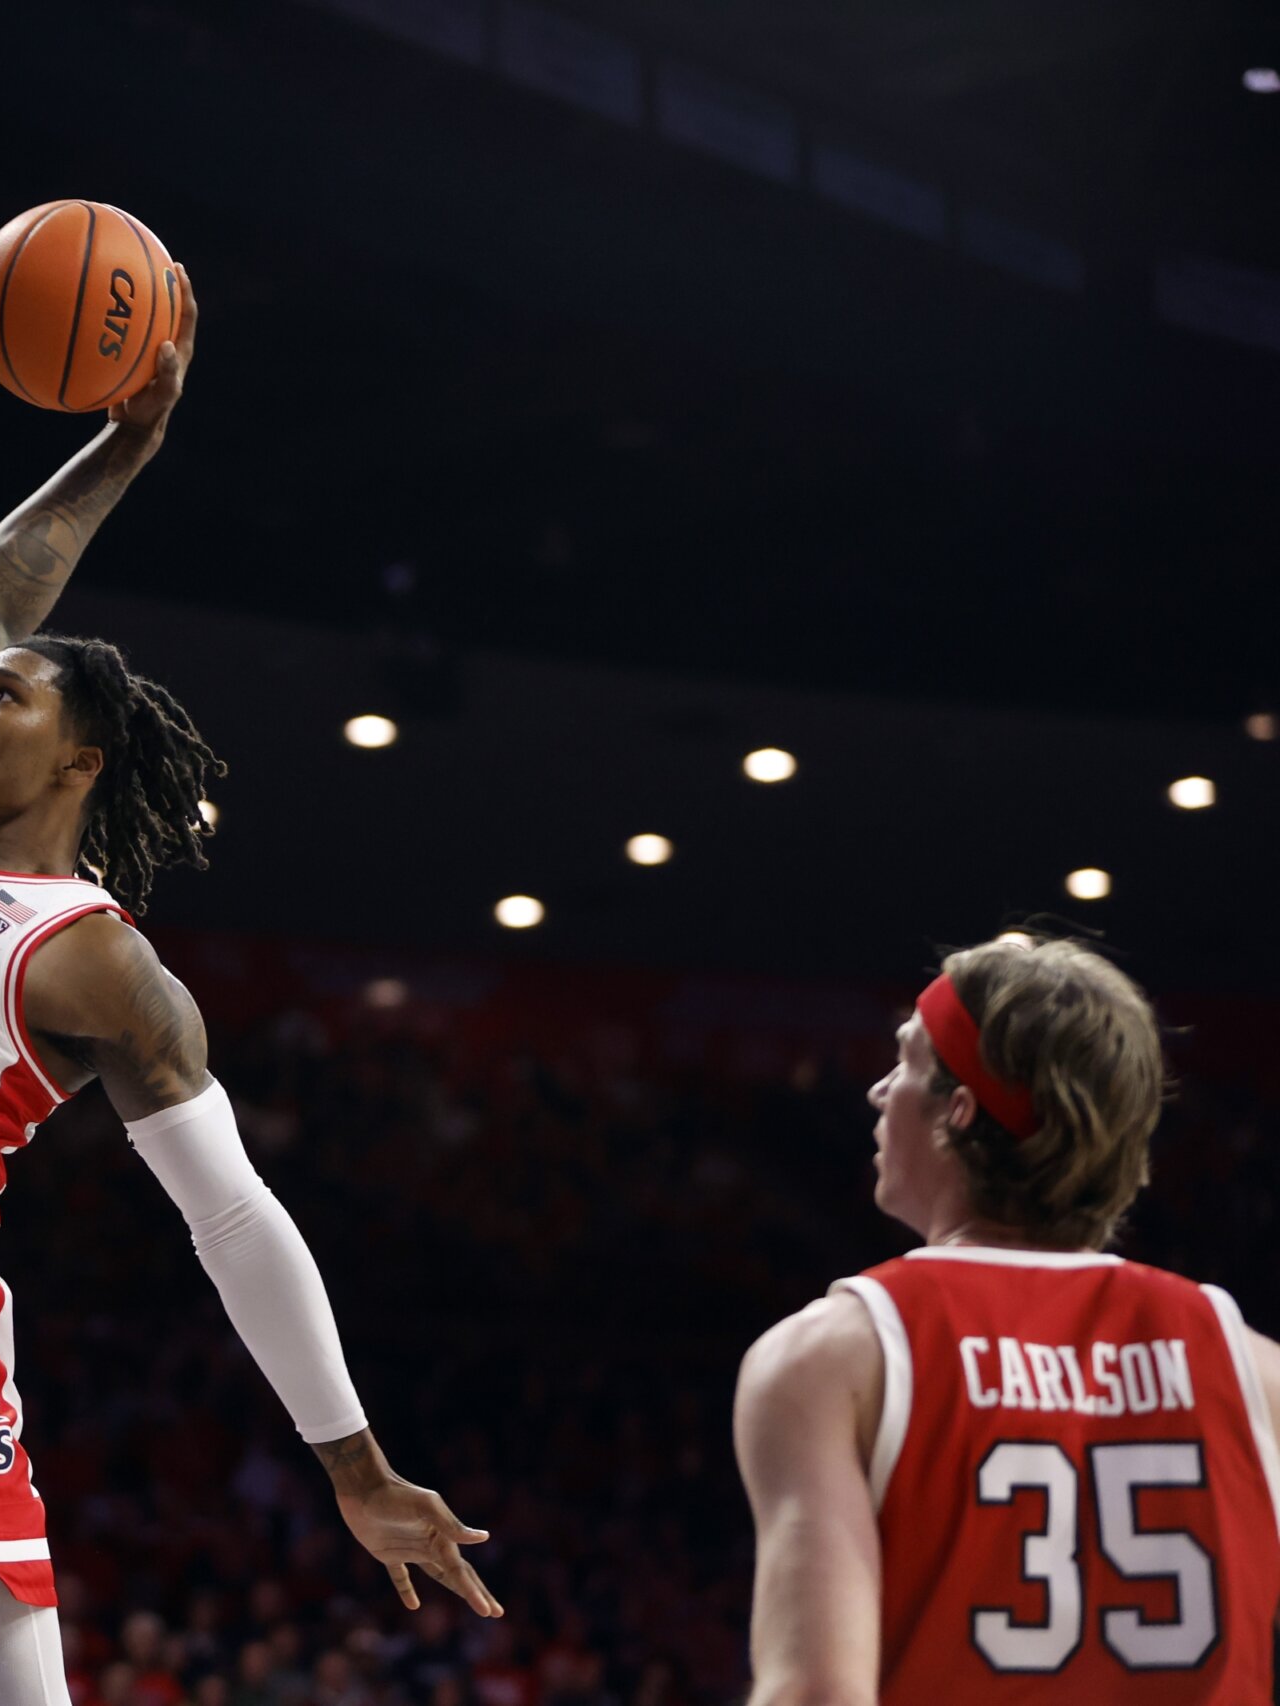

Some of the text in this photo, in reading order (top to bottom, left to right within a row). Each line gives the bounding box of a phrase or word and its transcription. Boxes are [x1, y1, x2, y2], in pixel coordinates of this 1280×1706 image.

[99, 268, 135, 362] CATS
[959, 1336, 1195, 1417] CARLSON
[969, 1439, 1222, 1675] 35
